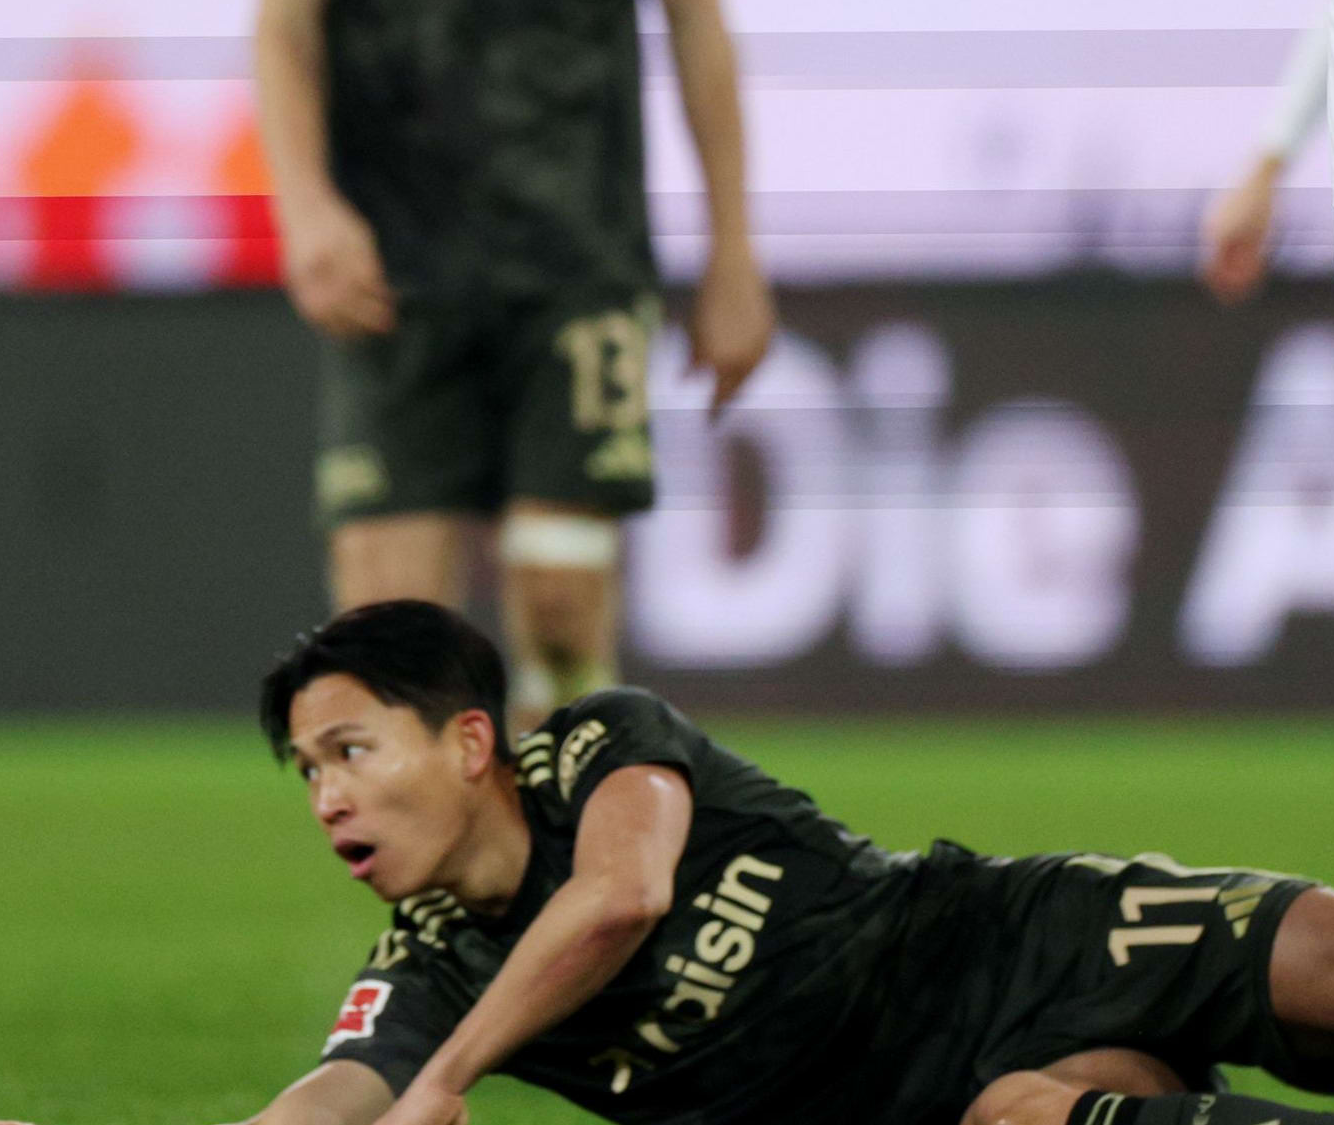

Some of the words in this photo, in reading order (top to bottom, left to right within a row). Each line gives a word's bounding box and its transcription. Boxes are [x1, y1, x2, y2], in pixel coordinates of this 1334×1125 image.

[555, 309, 650, 432] 13
[629, 318, 1141, 672] Die
[1108, 886, 1220, 967] 11
